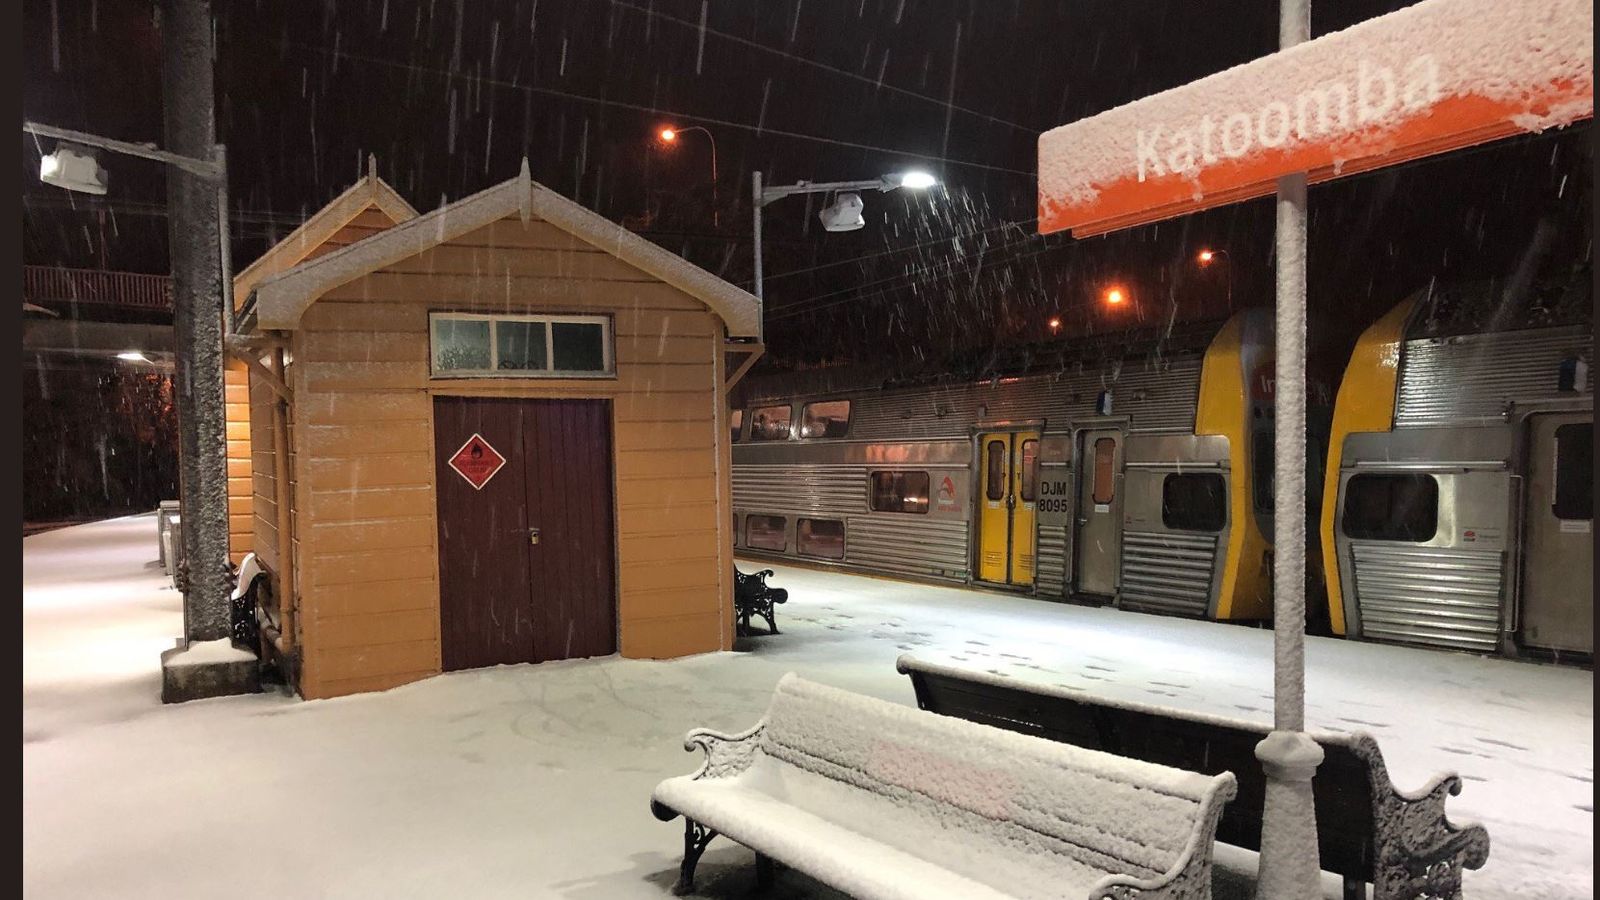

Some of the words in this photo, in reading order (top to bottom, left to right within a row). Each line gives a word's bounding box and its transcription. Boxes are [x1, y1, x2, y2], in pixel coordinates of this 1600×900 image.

[1136, 54, 1439, 182] Katoomba
[1041, 481, 1067, 496] DJM
[1039, 498, 1067, 512] 8095
